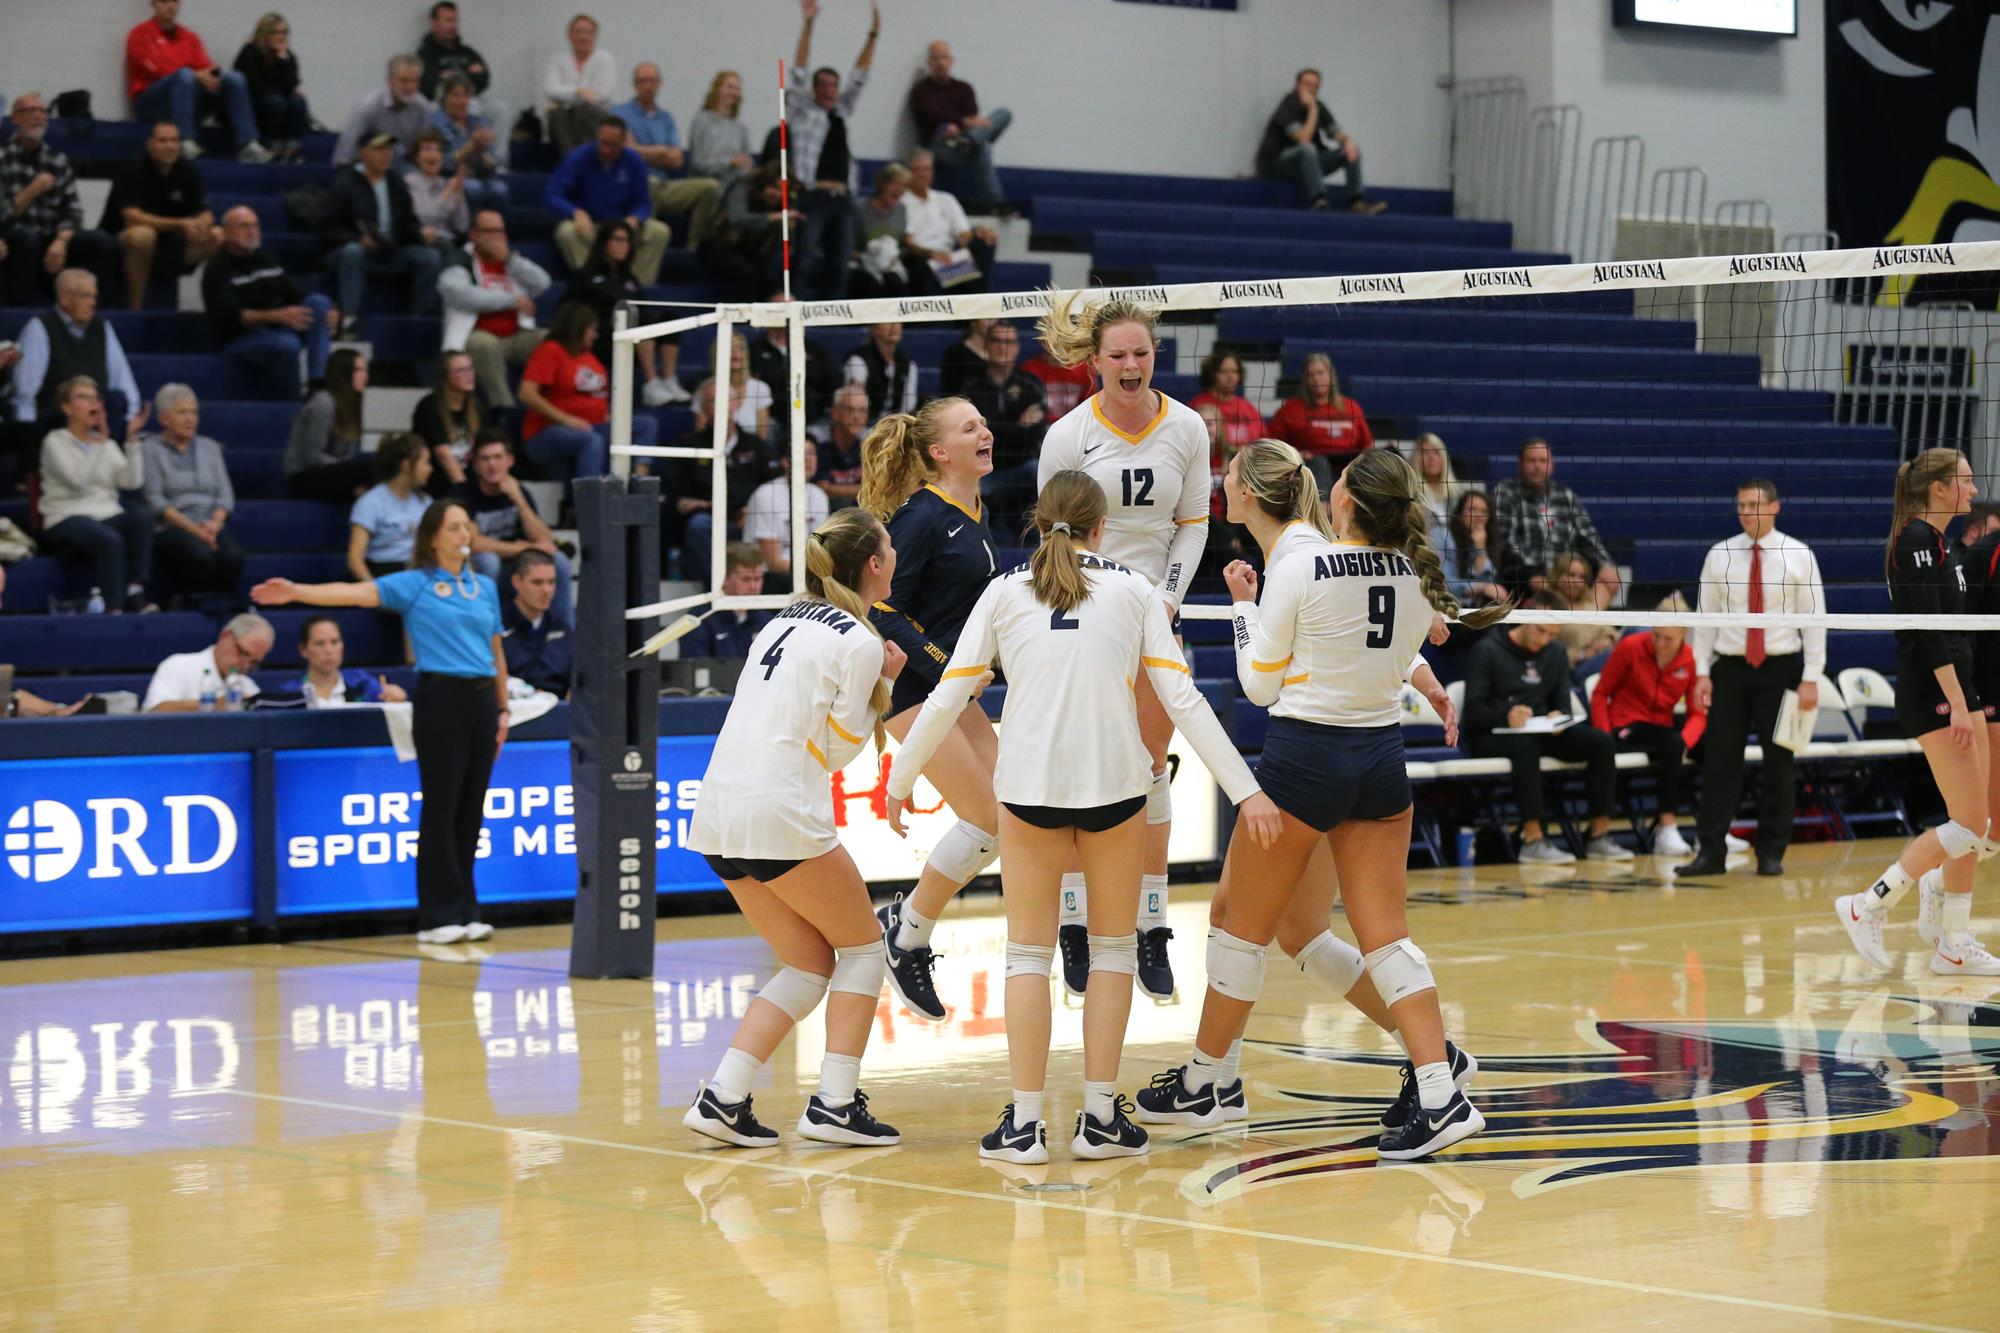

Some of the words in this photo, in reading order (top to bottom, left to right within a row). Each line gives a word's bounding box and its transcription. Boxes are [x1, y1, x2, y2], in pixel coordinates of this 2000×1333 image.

[1729, 253, 1807, 277] AUGUSTANA
[1873, 245, 1956, 269] AUGUSTANA
[1462, 268, 1533, 290] AUGUSTANA
[1592, 261, 1666, 284] AUGUSTANA
[1220, 281, 1284, 301] AUGUSTANA
[1339, 275, 1405, 296] AUGUSTANA
[800, 302, 854, 321] AUGUSTANA
[899, 299, 954, 316] AUGUSTANA
[1121, 468, 1155, 507] 12
[1913, 549, 1933, 568] 14
[1165, 562, 1182, 592] VIKINGS
[1366, 586, 1396, 649] 9
[759, 626, 796, 681] 4
